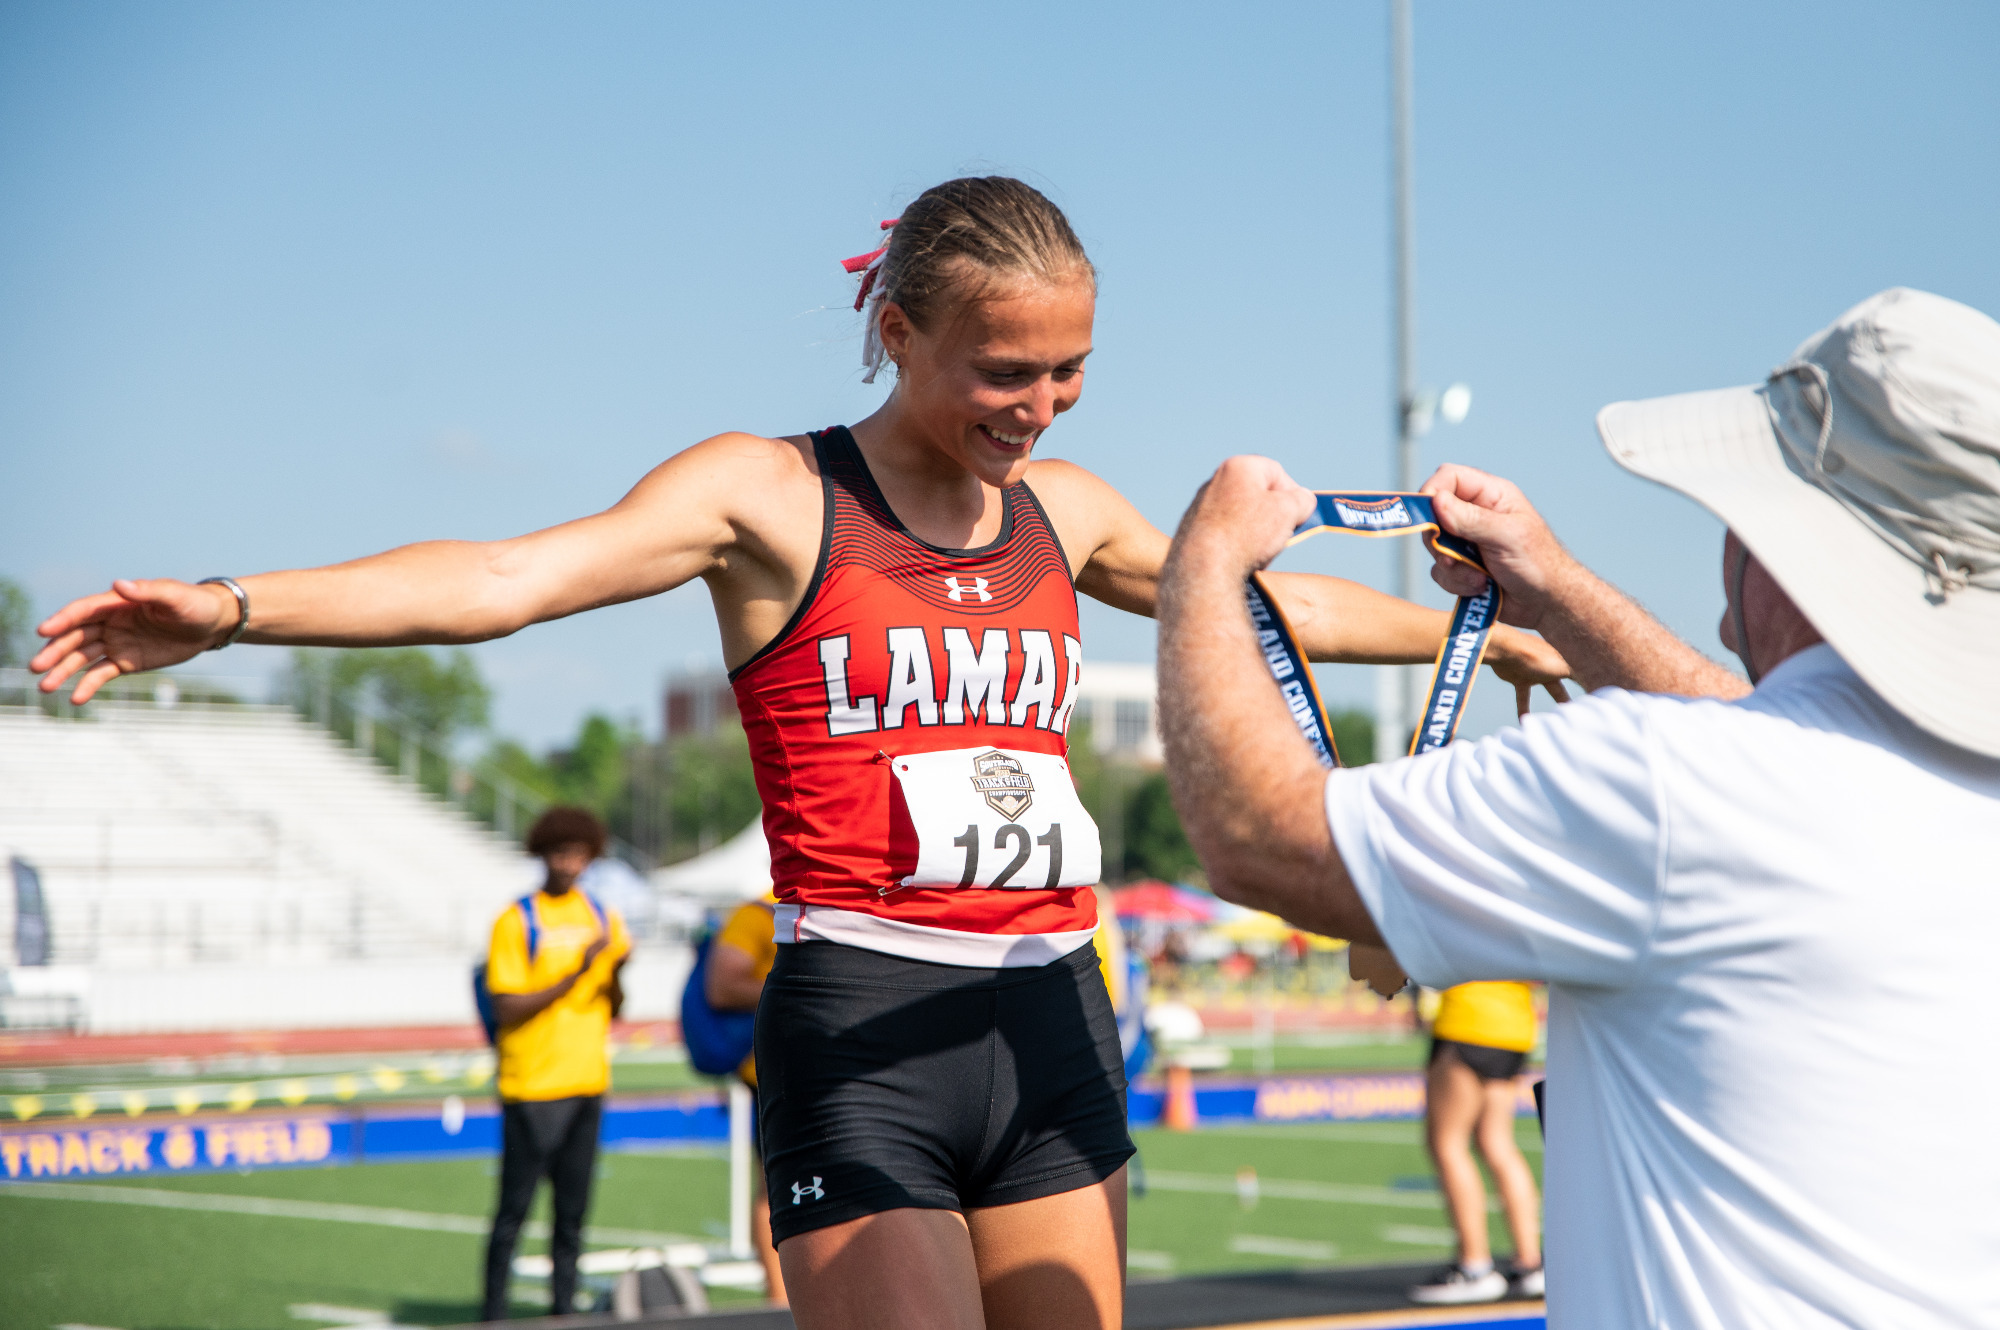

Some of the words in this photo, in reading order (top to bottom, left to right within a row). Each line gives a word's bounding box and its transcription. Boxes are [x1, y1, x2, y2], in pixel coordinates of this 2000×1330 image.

[1335, 501, 1411, 525] SOUTHLAND
[818, 626, 1082, 738] LAMAR
[976, 776, 1006, 788] TRACK
[1010, 776, 1029, 788] FIELD
[954, 823, 1063, 889] 121
[0, 1129, 151, 1177] TRACK
[204, 1119, 333, 1167] FIELD
